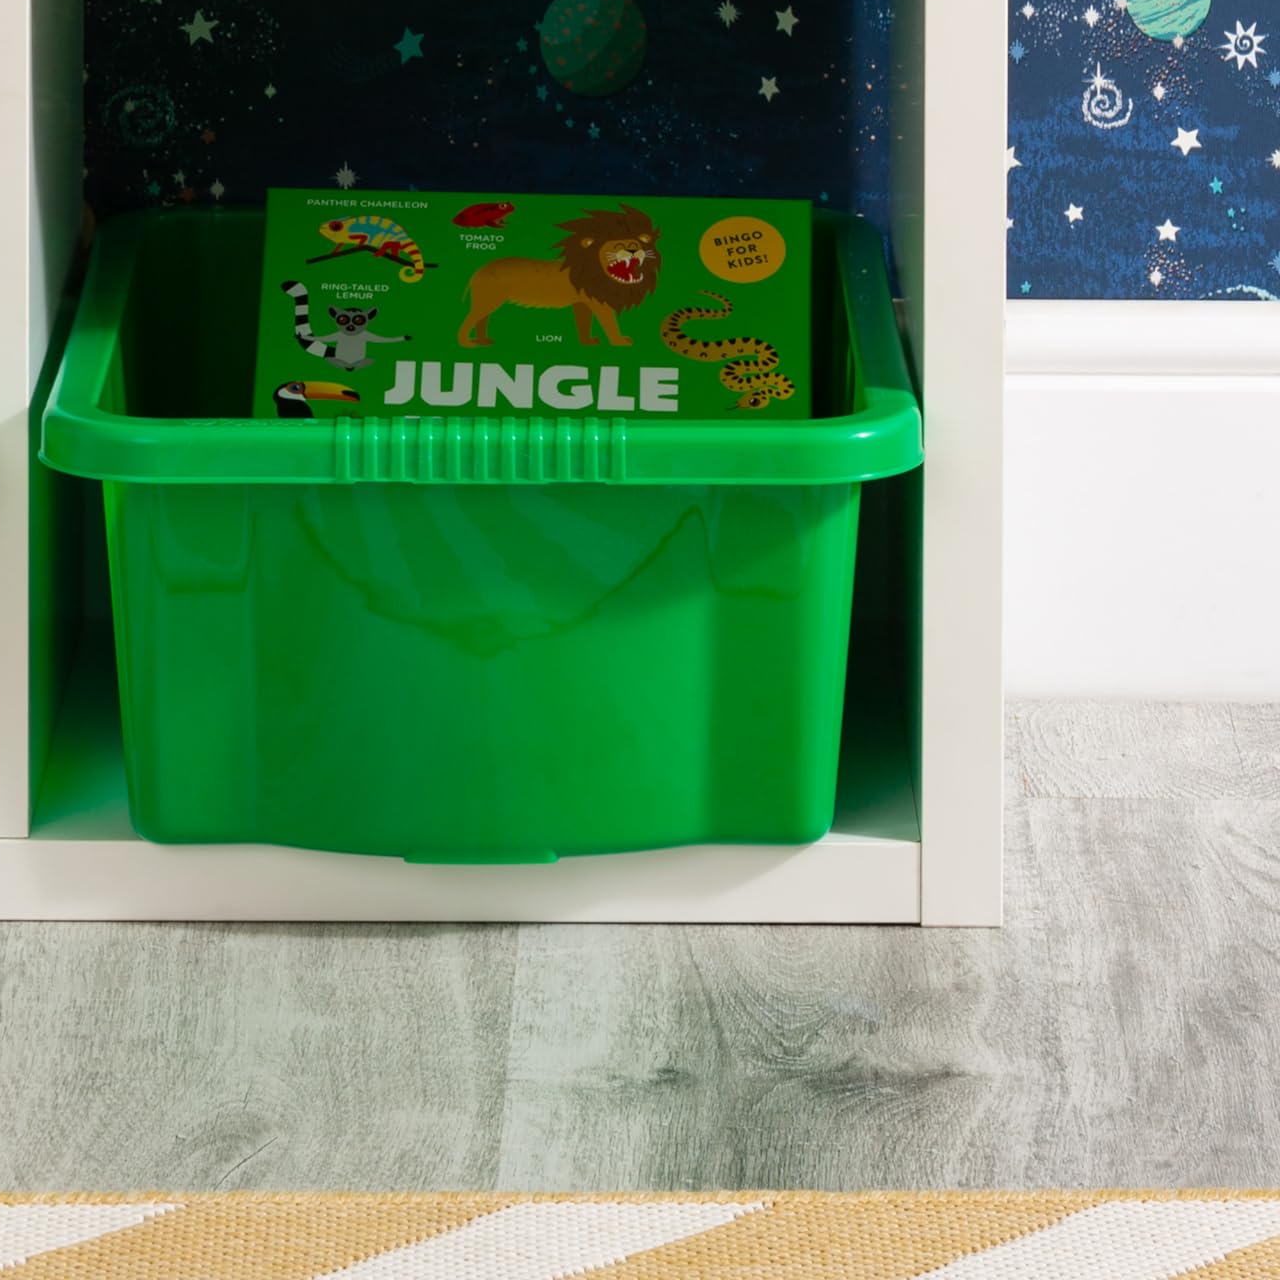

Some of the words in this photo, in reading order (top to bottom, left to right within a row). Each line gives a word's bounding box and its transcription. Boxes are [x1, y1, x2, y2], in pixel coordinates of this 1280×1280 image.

[306, 198, 358, 207] PANTHER
[360, 200, 429, 209] CHAMELEON
[459, 234, 505, 242] TOMATO
[713, 230, 763, 247] BINGO
[465, 242, 497, 250] FROG
[726, 244, 758, 257] FOR
[727, 254, 769, 270] KIDS!
[321, 282, 390, 292] RING-TAILED
[336, 291, 374, 300] LEMUR
[535, 334, 563, 343] LION
[383, 360, 680, 412] JUNGLE
